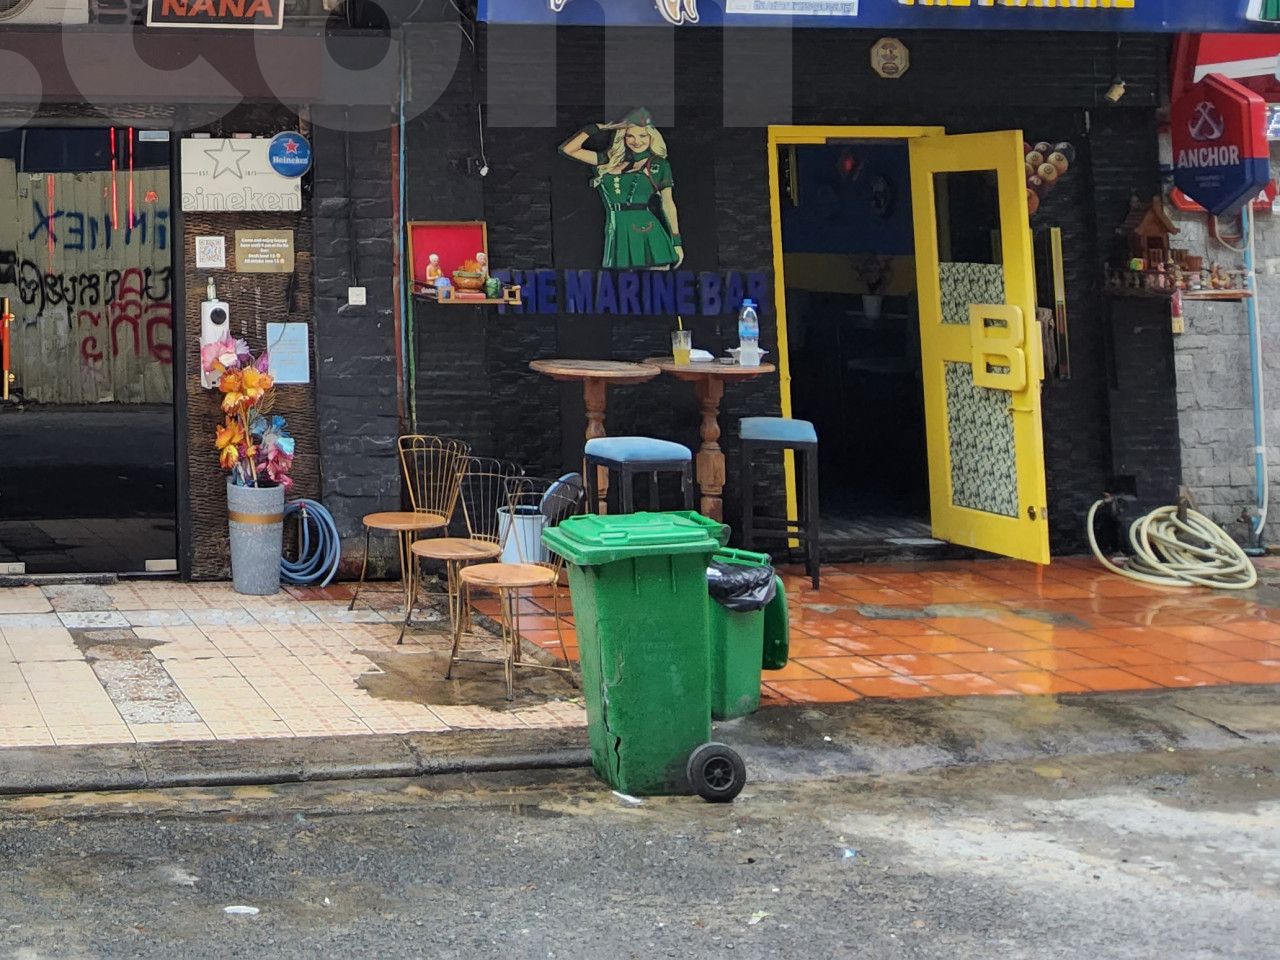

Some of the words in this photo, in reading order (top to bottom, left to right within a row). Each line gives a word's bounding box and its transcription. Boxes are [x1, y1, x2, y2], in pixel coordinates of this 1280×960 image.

[272, 155, 309, 165] Heineken
[1178, 145, 1240, 169] ANCHOR
[565, 269, 697, 316] MARINE
